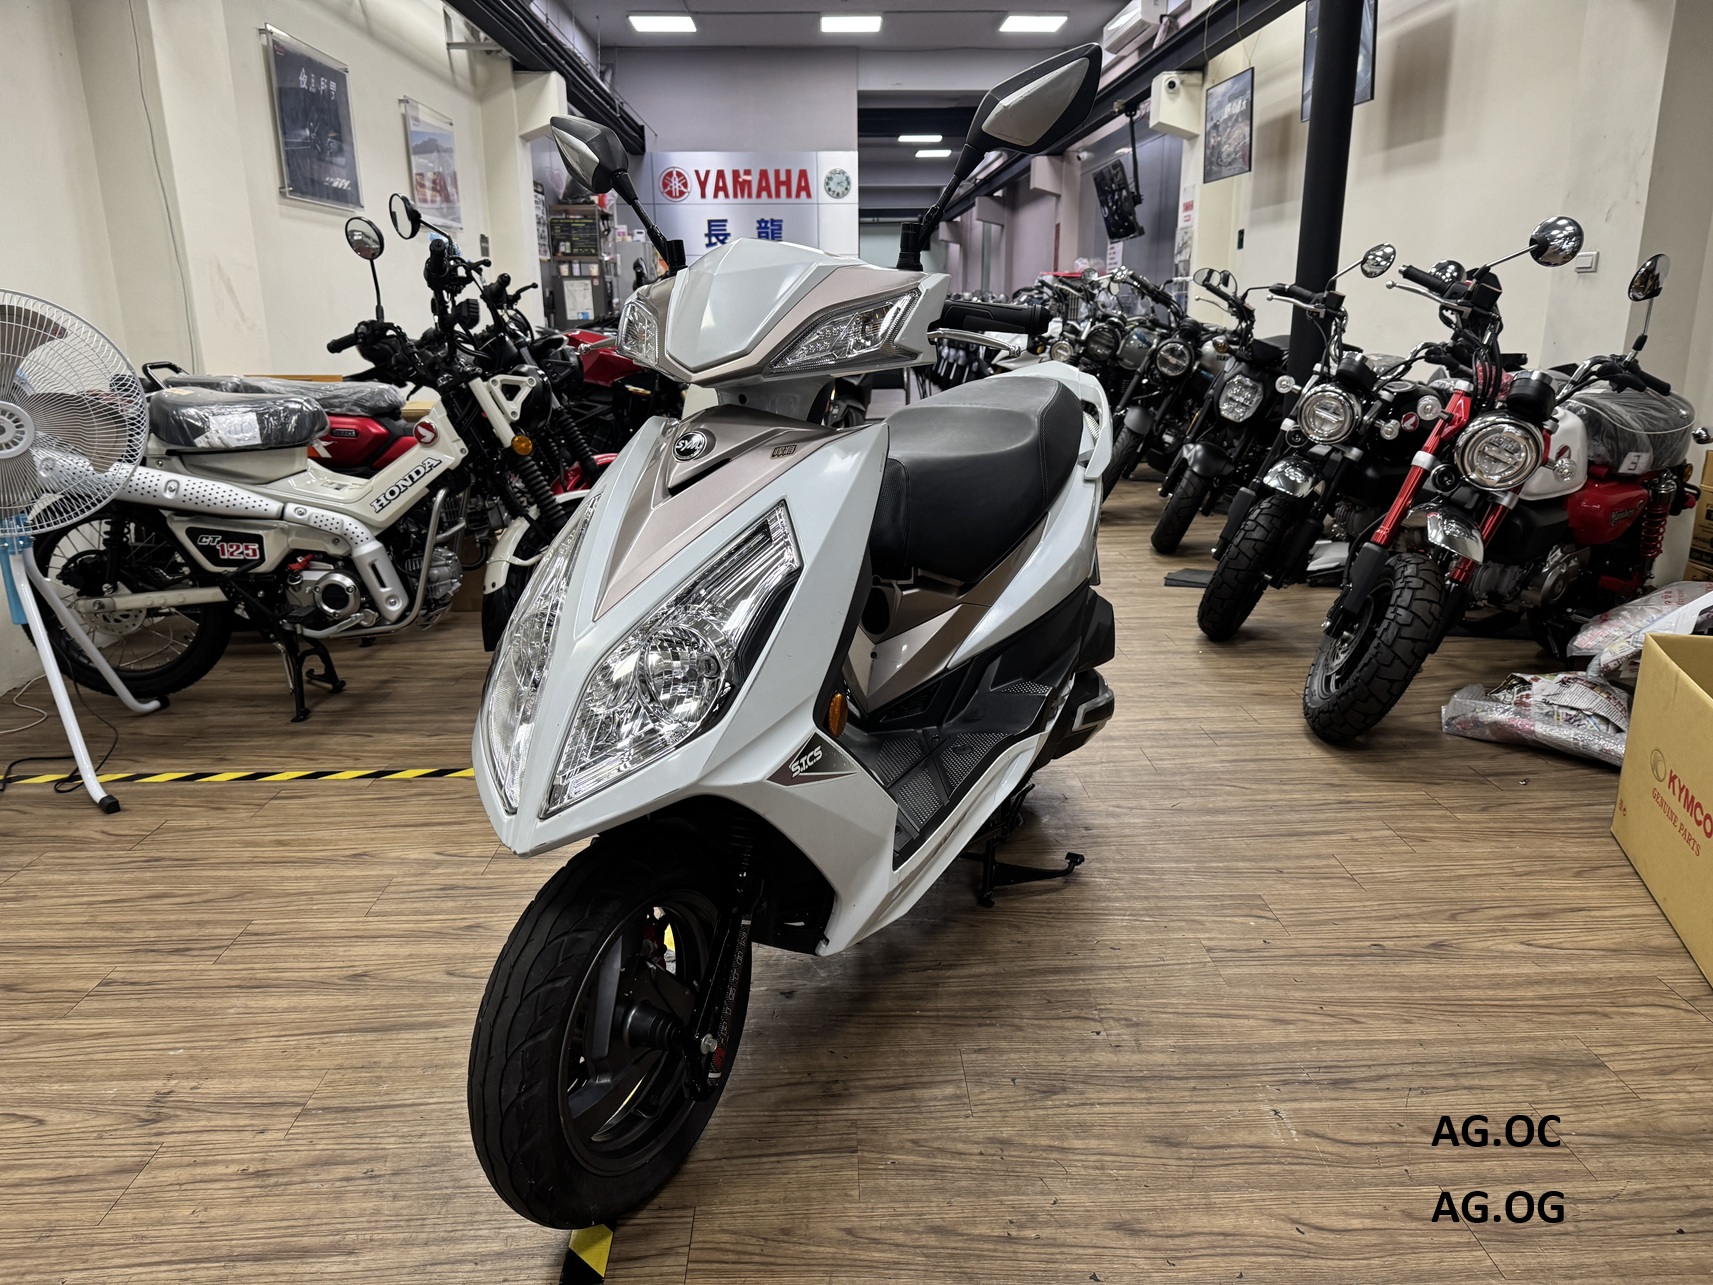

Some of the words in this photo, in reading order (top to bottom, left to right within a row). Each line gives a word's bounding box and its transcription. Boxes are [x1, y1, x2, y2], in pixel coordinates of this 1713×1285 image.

[695, 168, 812, 199] YAMAHA
[674, 439, 704, 452] SYM
[370, 457, 442, 513] HONDA
[197, 534, 222, 546] CT
[216, 542, 260, 560] 125
[1668, 768, 1713, 839] KYMCO
[1652, 787, 1678, 827] GENUINE
[1678, 823, 1701, 857] PARTS
